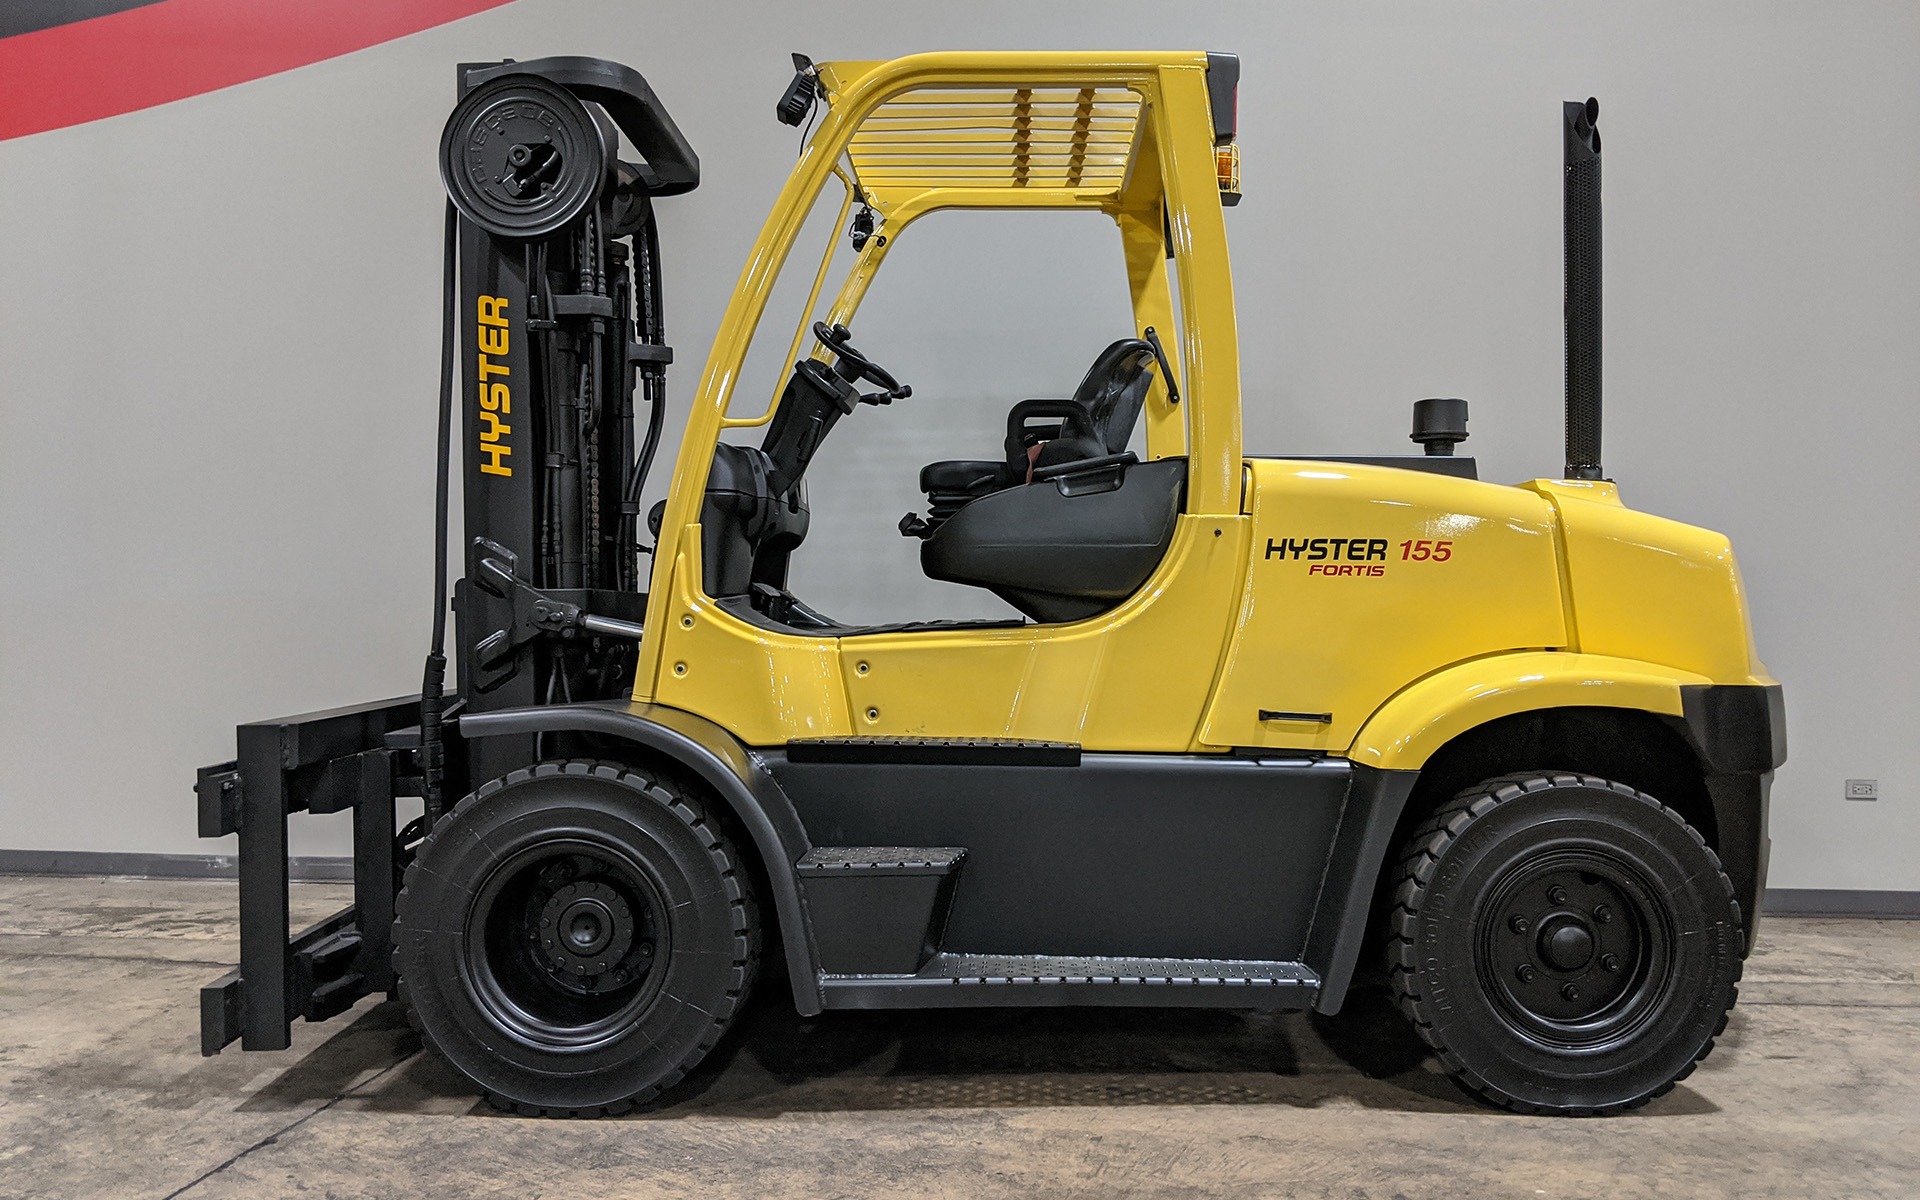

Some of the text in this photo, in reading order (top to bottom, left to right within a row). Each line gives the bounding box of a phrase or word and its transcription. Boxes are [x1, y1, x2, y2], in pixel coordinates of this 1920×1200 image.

[477, 294, 512, 477] HYSTER
[1264, 537, 1453, 562] HYSTER 155
[1308, 564, 1385, 577] FORTIS
